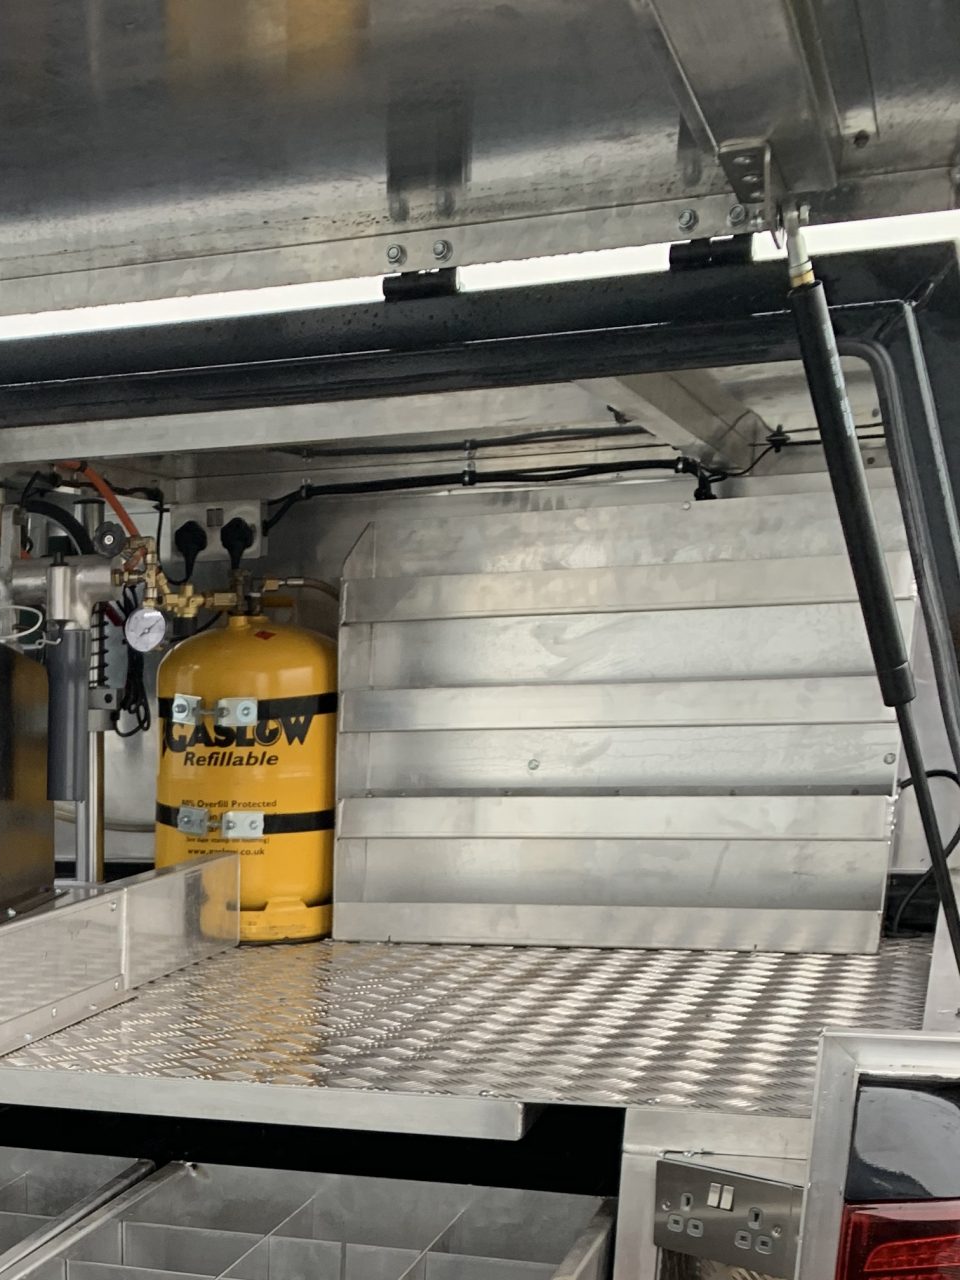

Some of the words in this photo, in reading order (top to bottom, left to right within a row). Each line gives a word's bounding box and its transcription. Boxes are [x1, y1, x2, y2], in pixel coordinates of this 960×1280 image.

[183, 751, 279, 767] Refillable
[197, 799, 229, 808] Overfill
[231, 799, 277, 808] Protected
